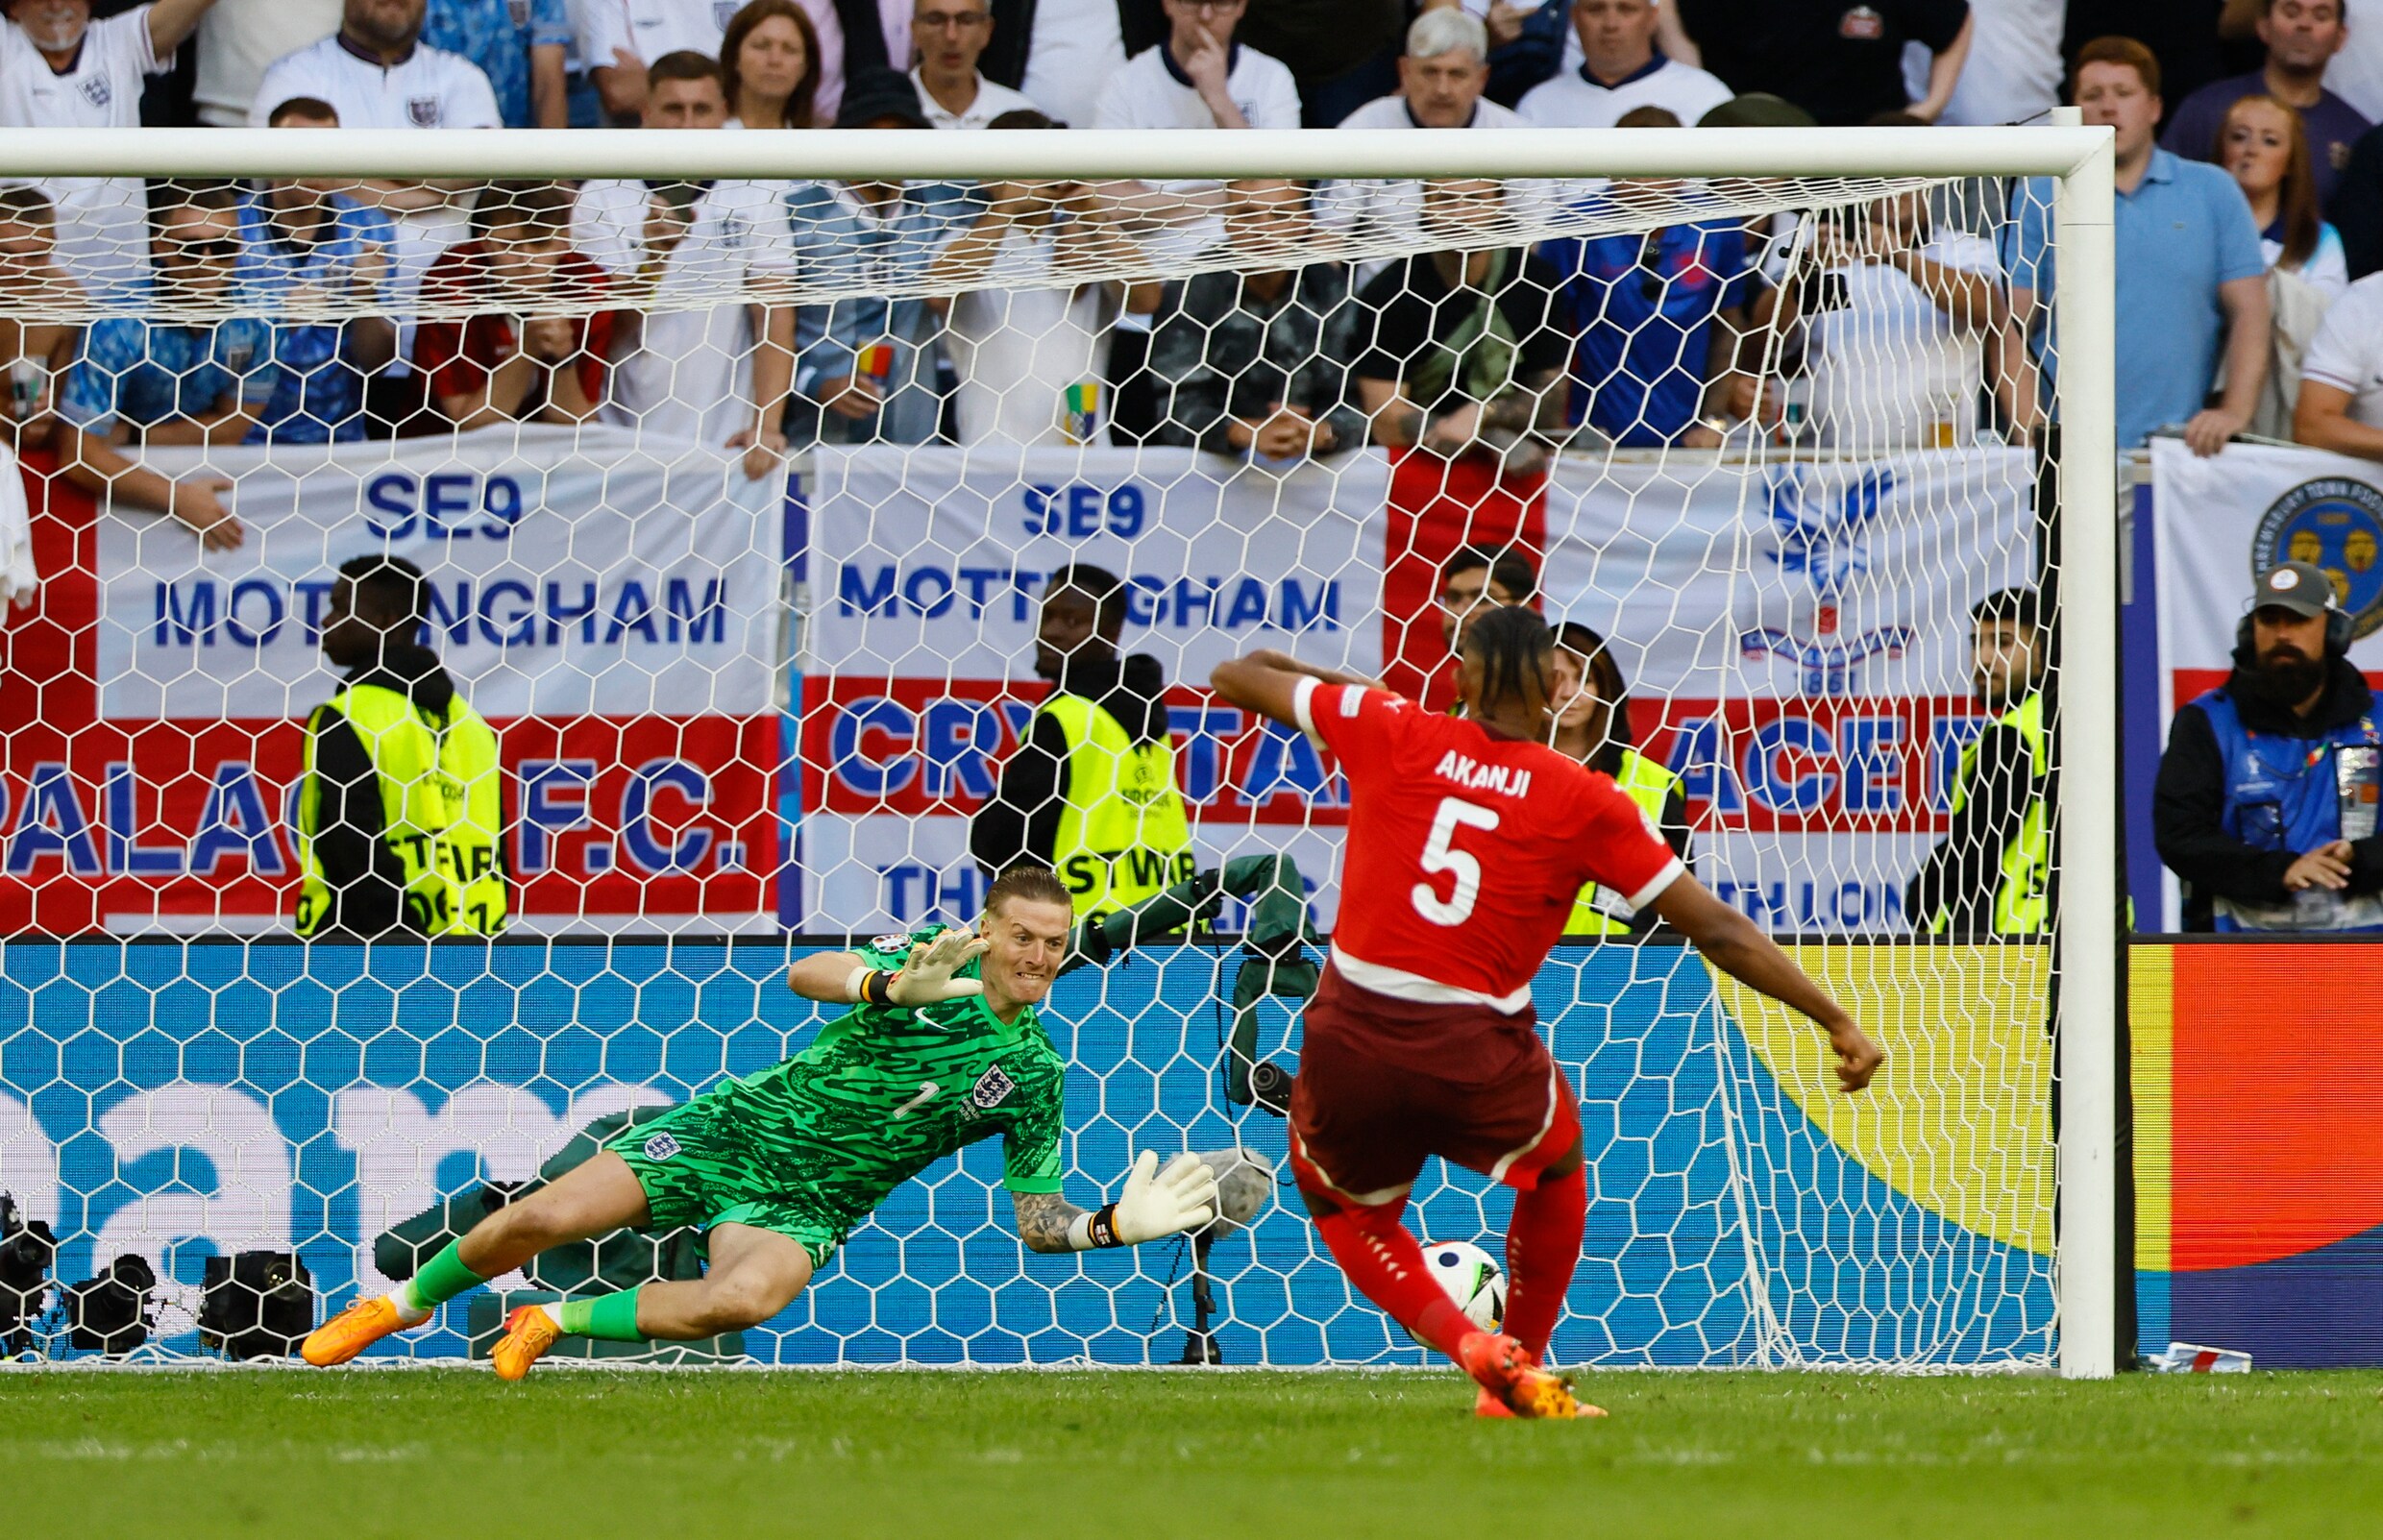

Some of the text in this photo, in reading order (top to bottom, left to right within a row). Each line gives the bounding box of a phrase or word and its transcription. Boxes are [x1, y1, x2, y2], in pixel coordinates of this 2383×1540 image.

[367, 474, 521, 540] SE9
[1022, 483, 1143, 538] SE9
[156, 578, 726, 648] MOTNGHAM
[840, 565, 1339, 631] MOTTGHAM
[828, 694, 1351, 809] CRTA
[1435, 749, 1532, 798] AKANJI
[0, 757, 748, 877] ALA F.C.
[1412, 796, 1500, 926] 5
[893, 1081, 940, 1119] 1
